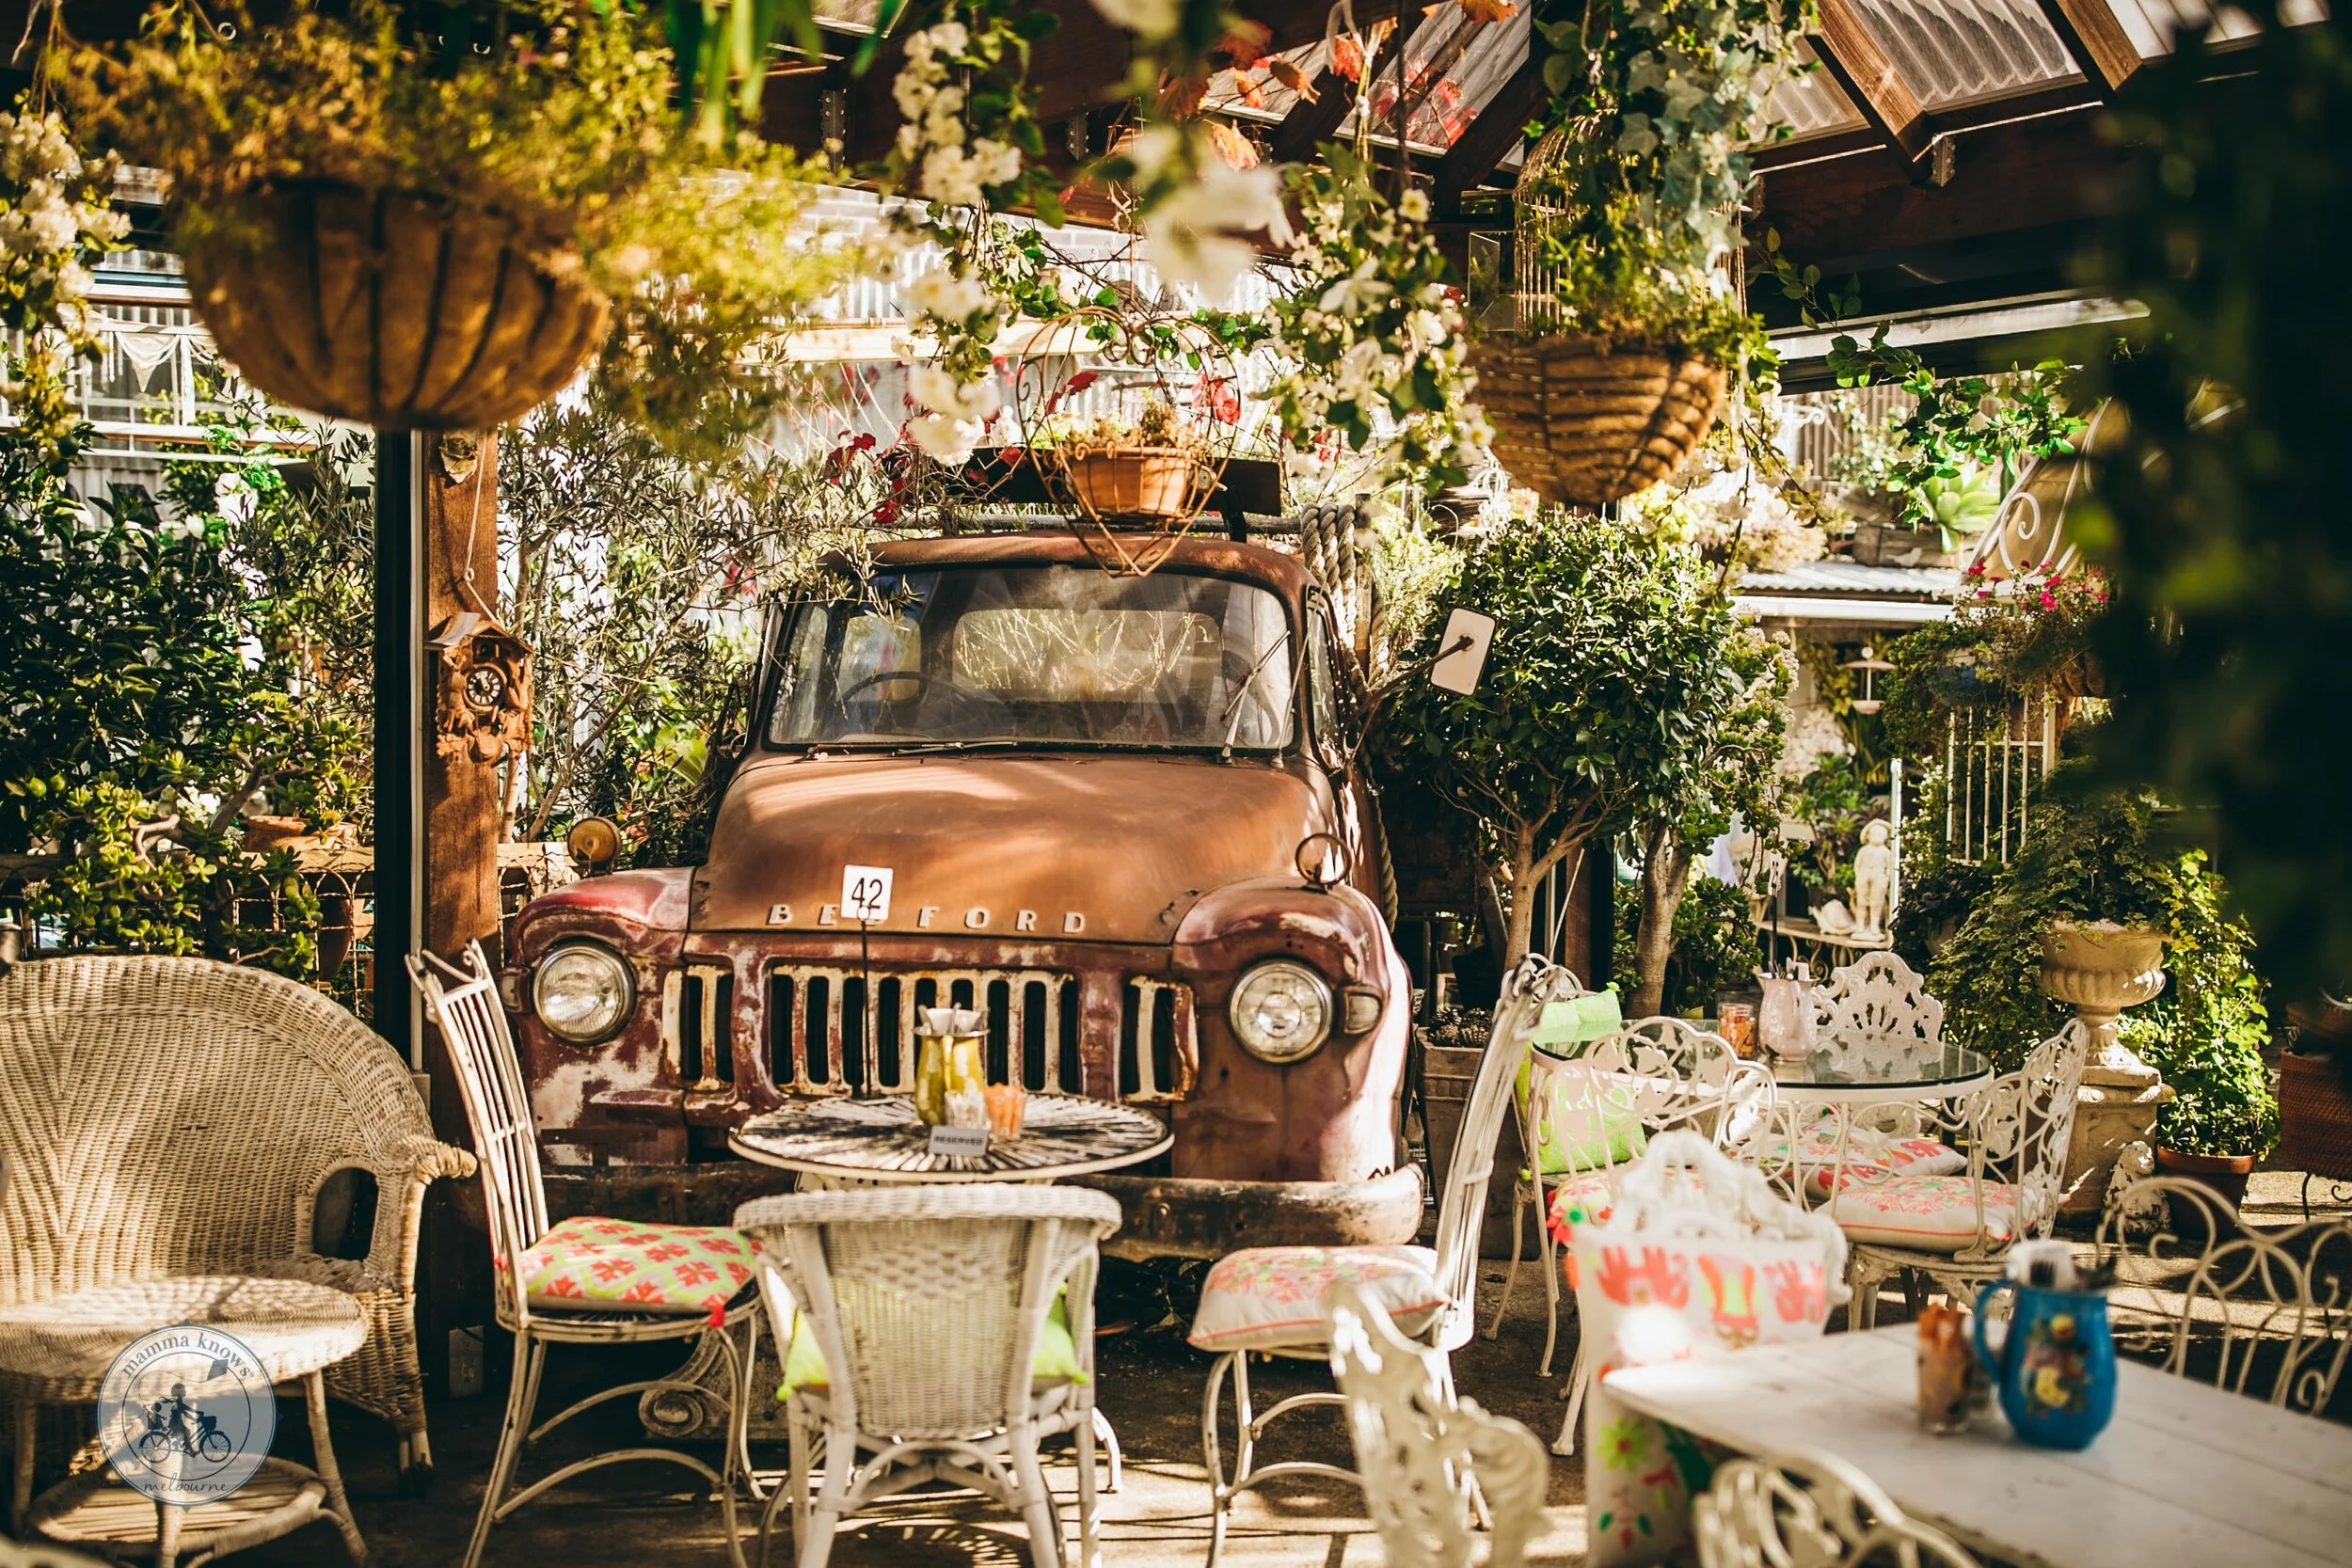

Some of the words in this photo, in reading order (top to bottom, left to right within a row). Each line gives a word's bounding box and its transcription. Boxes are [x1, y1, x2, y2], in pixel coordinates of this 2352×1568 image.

[850, 877, 882, 910] 42
[766, 903, 1086, 934] BEFORD
[933, 1135, 984, 1147] RESERVED
